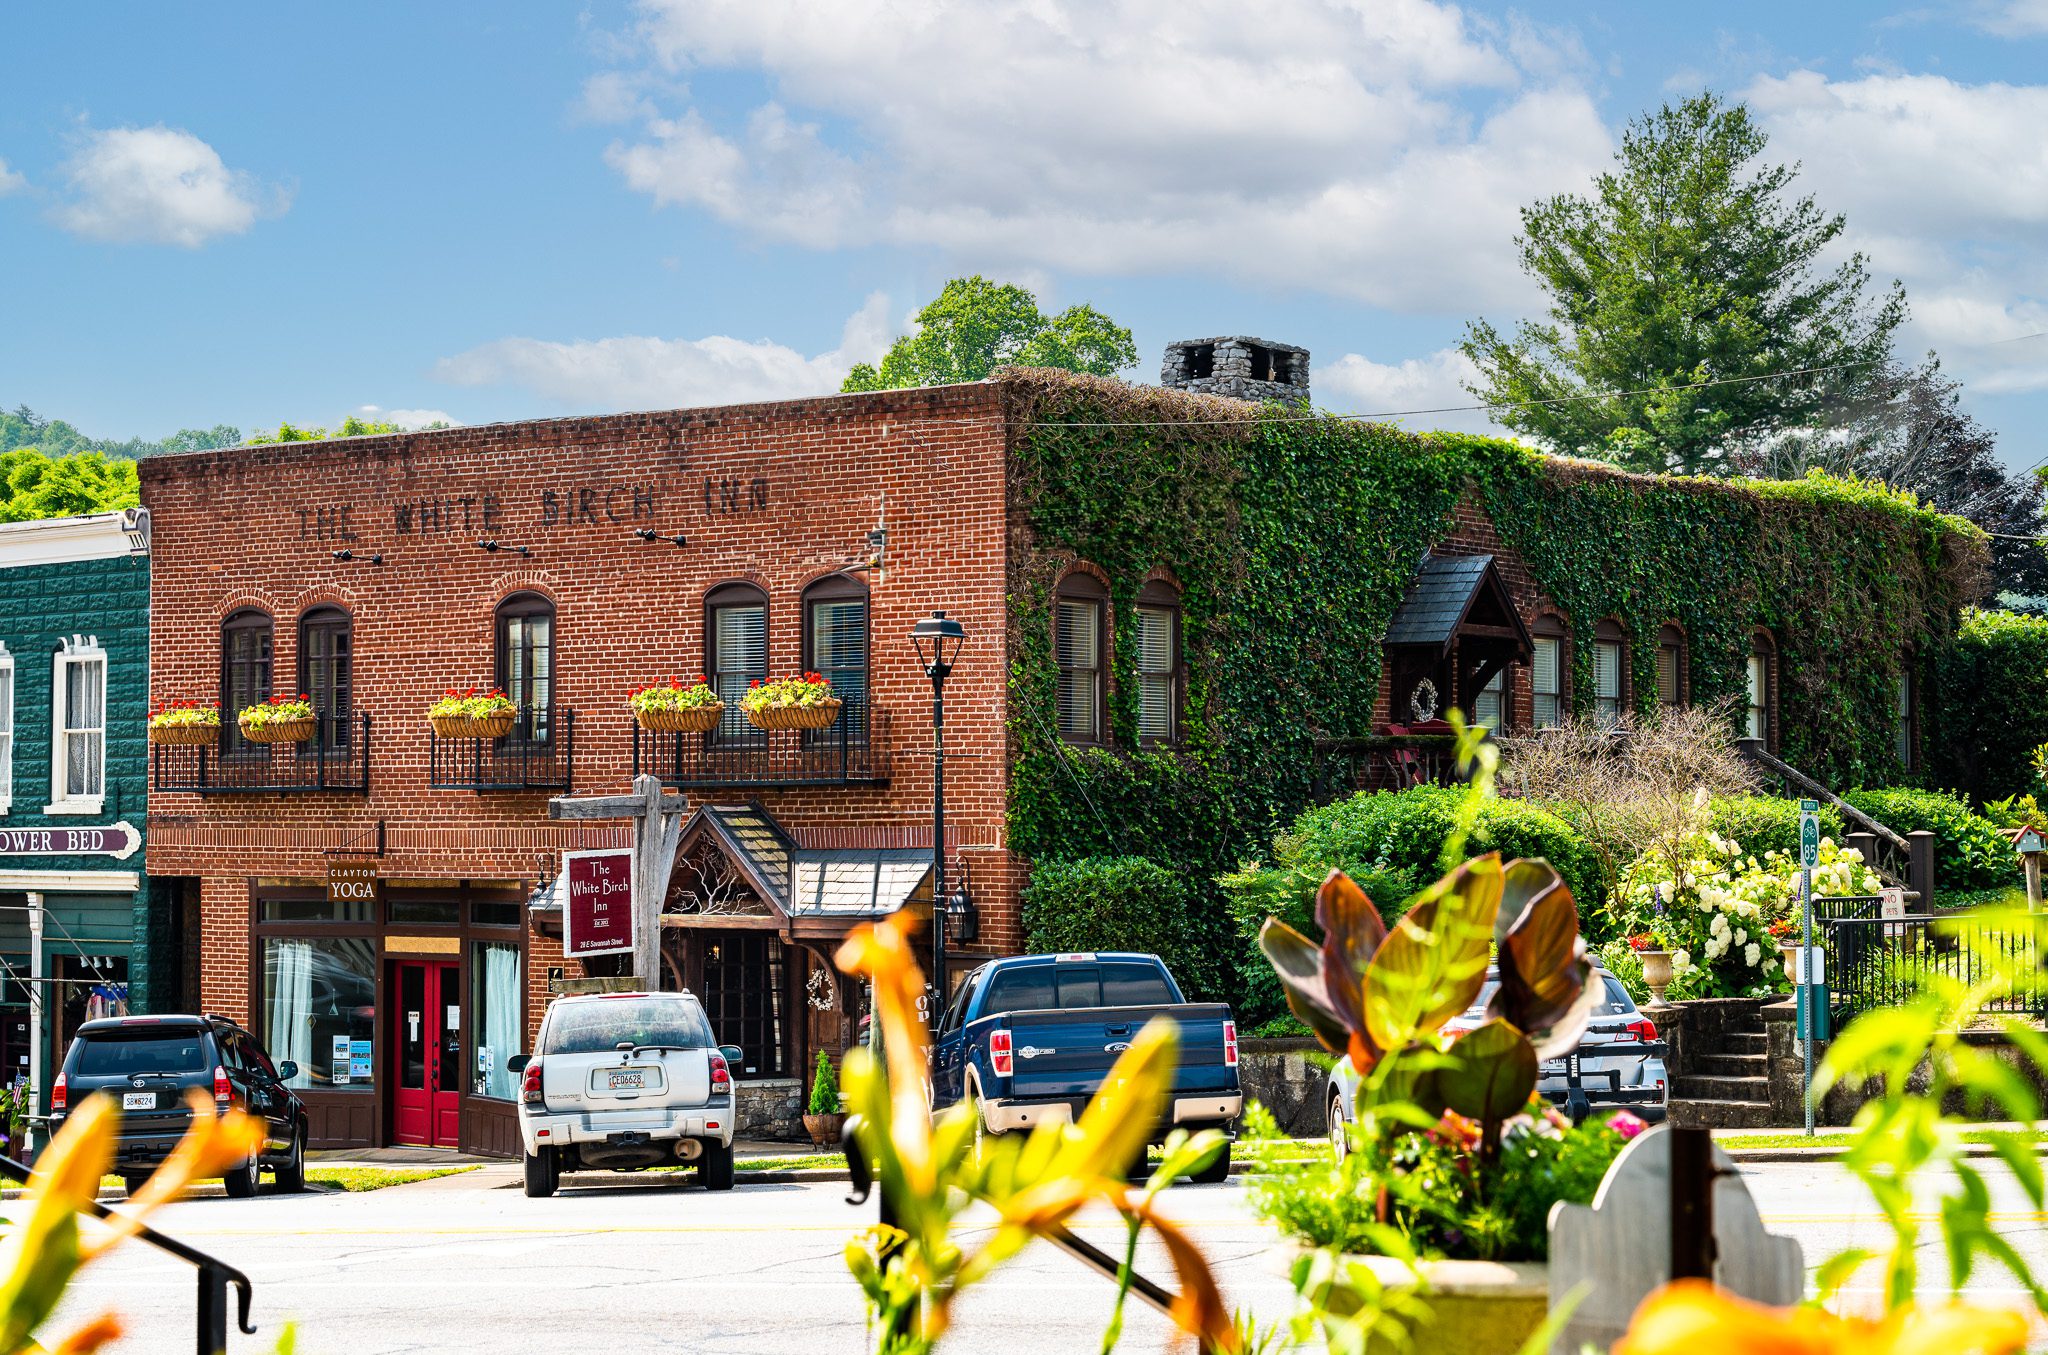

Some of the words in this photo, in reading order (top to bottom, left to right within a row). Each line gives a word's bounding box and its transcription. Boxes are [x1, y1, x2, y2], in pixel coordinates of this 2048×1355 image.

[295, 506, 357, 541] THE
[394, 496, 501, 534] WHITE
[542, 484, 654, 526] BIRCH
[705, 478, 767, 515] INN
[66, 830, 104, 851] BED
[1804, 844, 1816, 860] 85
[330, 869, 376, 877] CLAYTON
[590, 861, 610, 877] The
[330, 882, 375, 898] YOGA
[572, 880, 600, 897] White
[602, 877, 628, 895] Birch
[594, 897, 608, 913] Inn
[1884, 894, 1897, 904] NO
[1570, 1054, 1578, 1078] THULE
